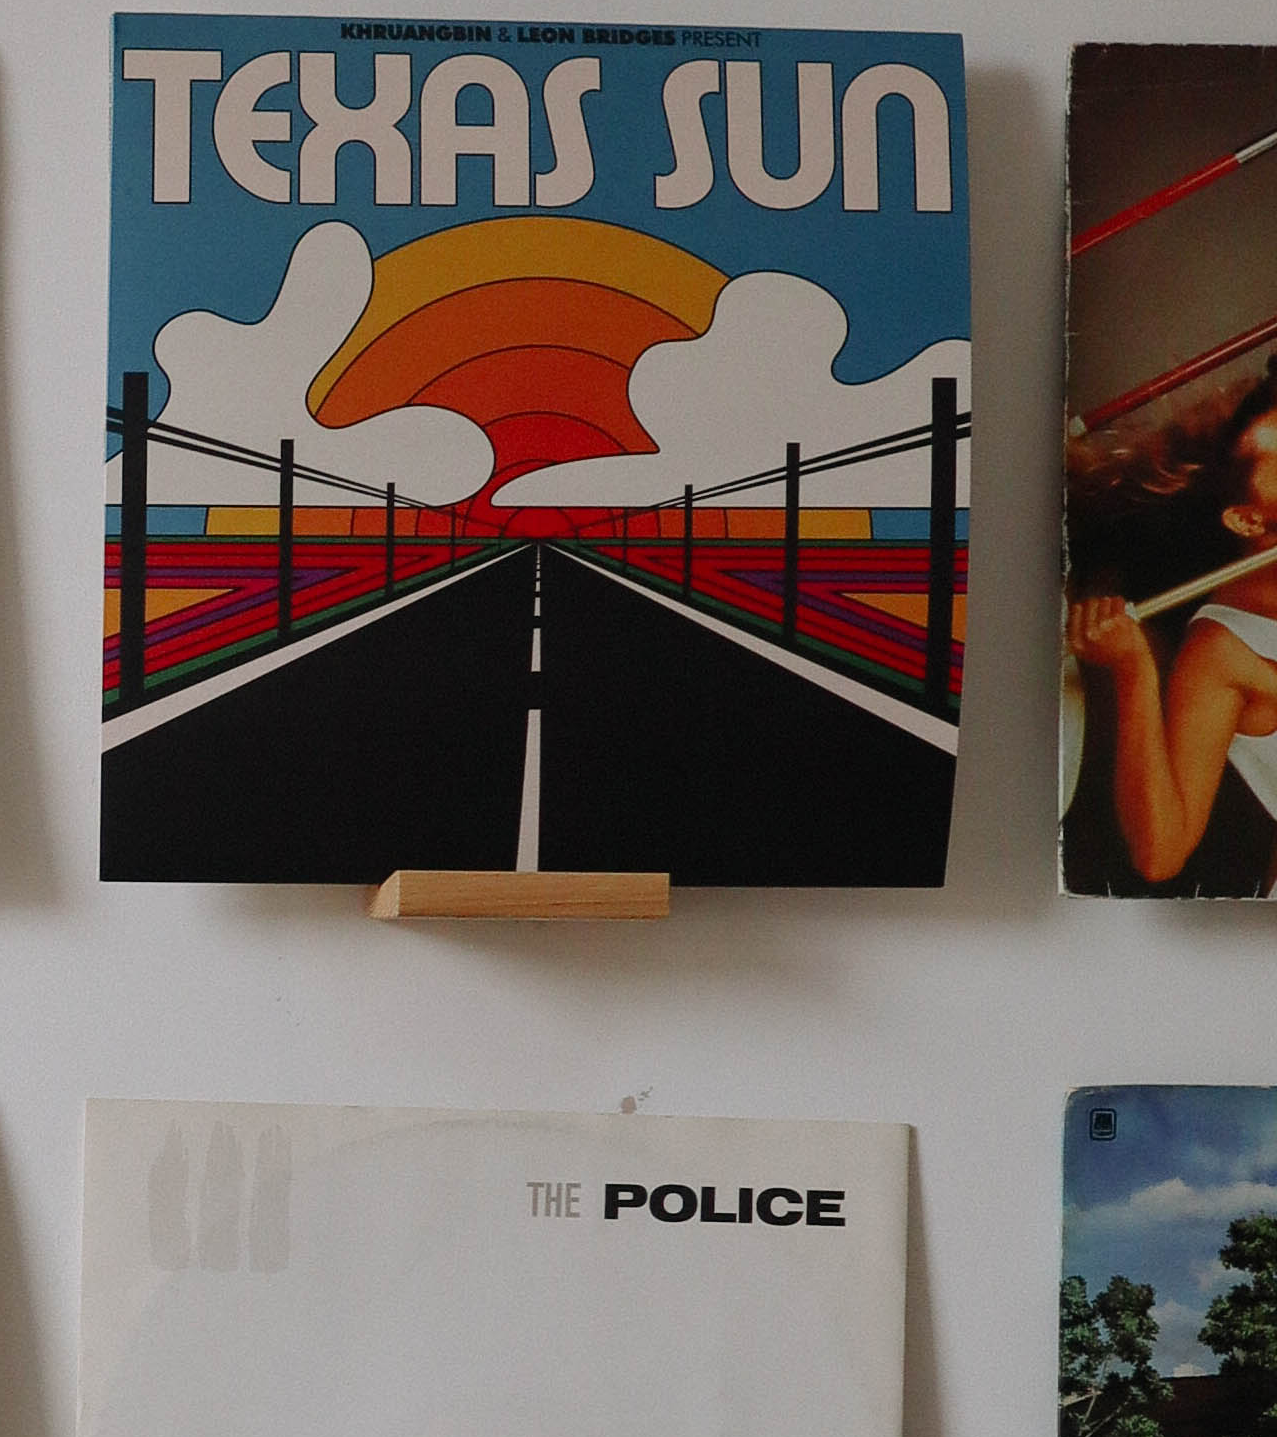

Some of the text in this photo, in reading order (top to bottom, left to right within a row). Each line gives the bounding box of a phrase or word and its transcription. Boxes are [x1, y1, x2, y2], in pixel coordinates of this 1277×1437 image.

[340, 23, 762, 48] KHRUANGBIN & LEON BRIDGES PRESENT
[122, 48, 954, 213] TEXAS SUN
[526, 1181, 847, 1227] THE POLICE
